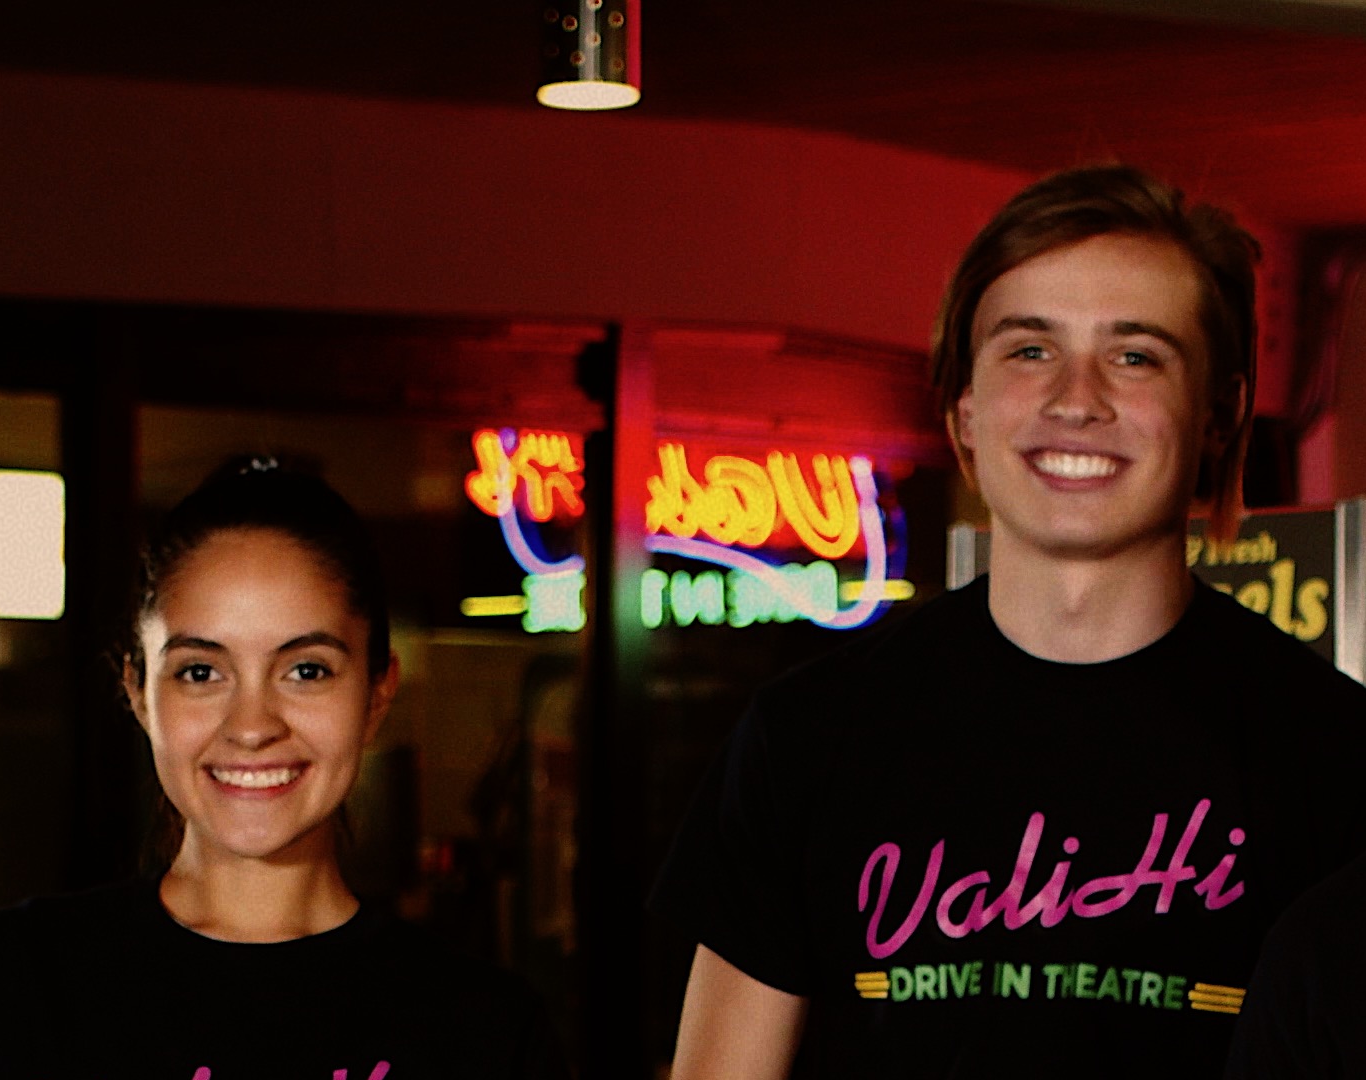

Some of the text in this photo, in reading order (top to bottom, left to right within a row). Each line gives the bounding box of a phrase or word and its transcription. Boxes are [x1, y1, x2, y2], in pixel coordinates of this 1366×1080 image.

[1210, 556, 1331, 642] els
[889, 961, 1187, 1009] DRIVE IN THEATRE
